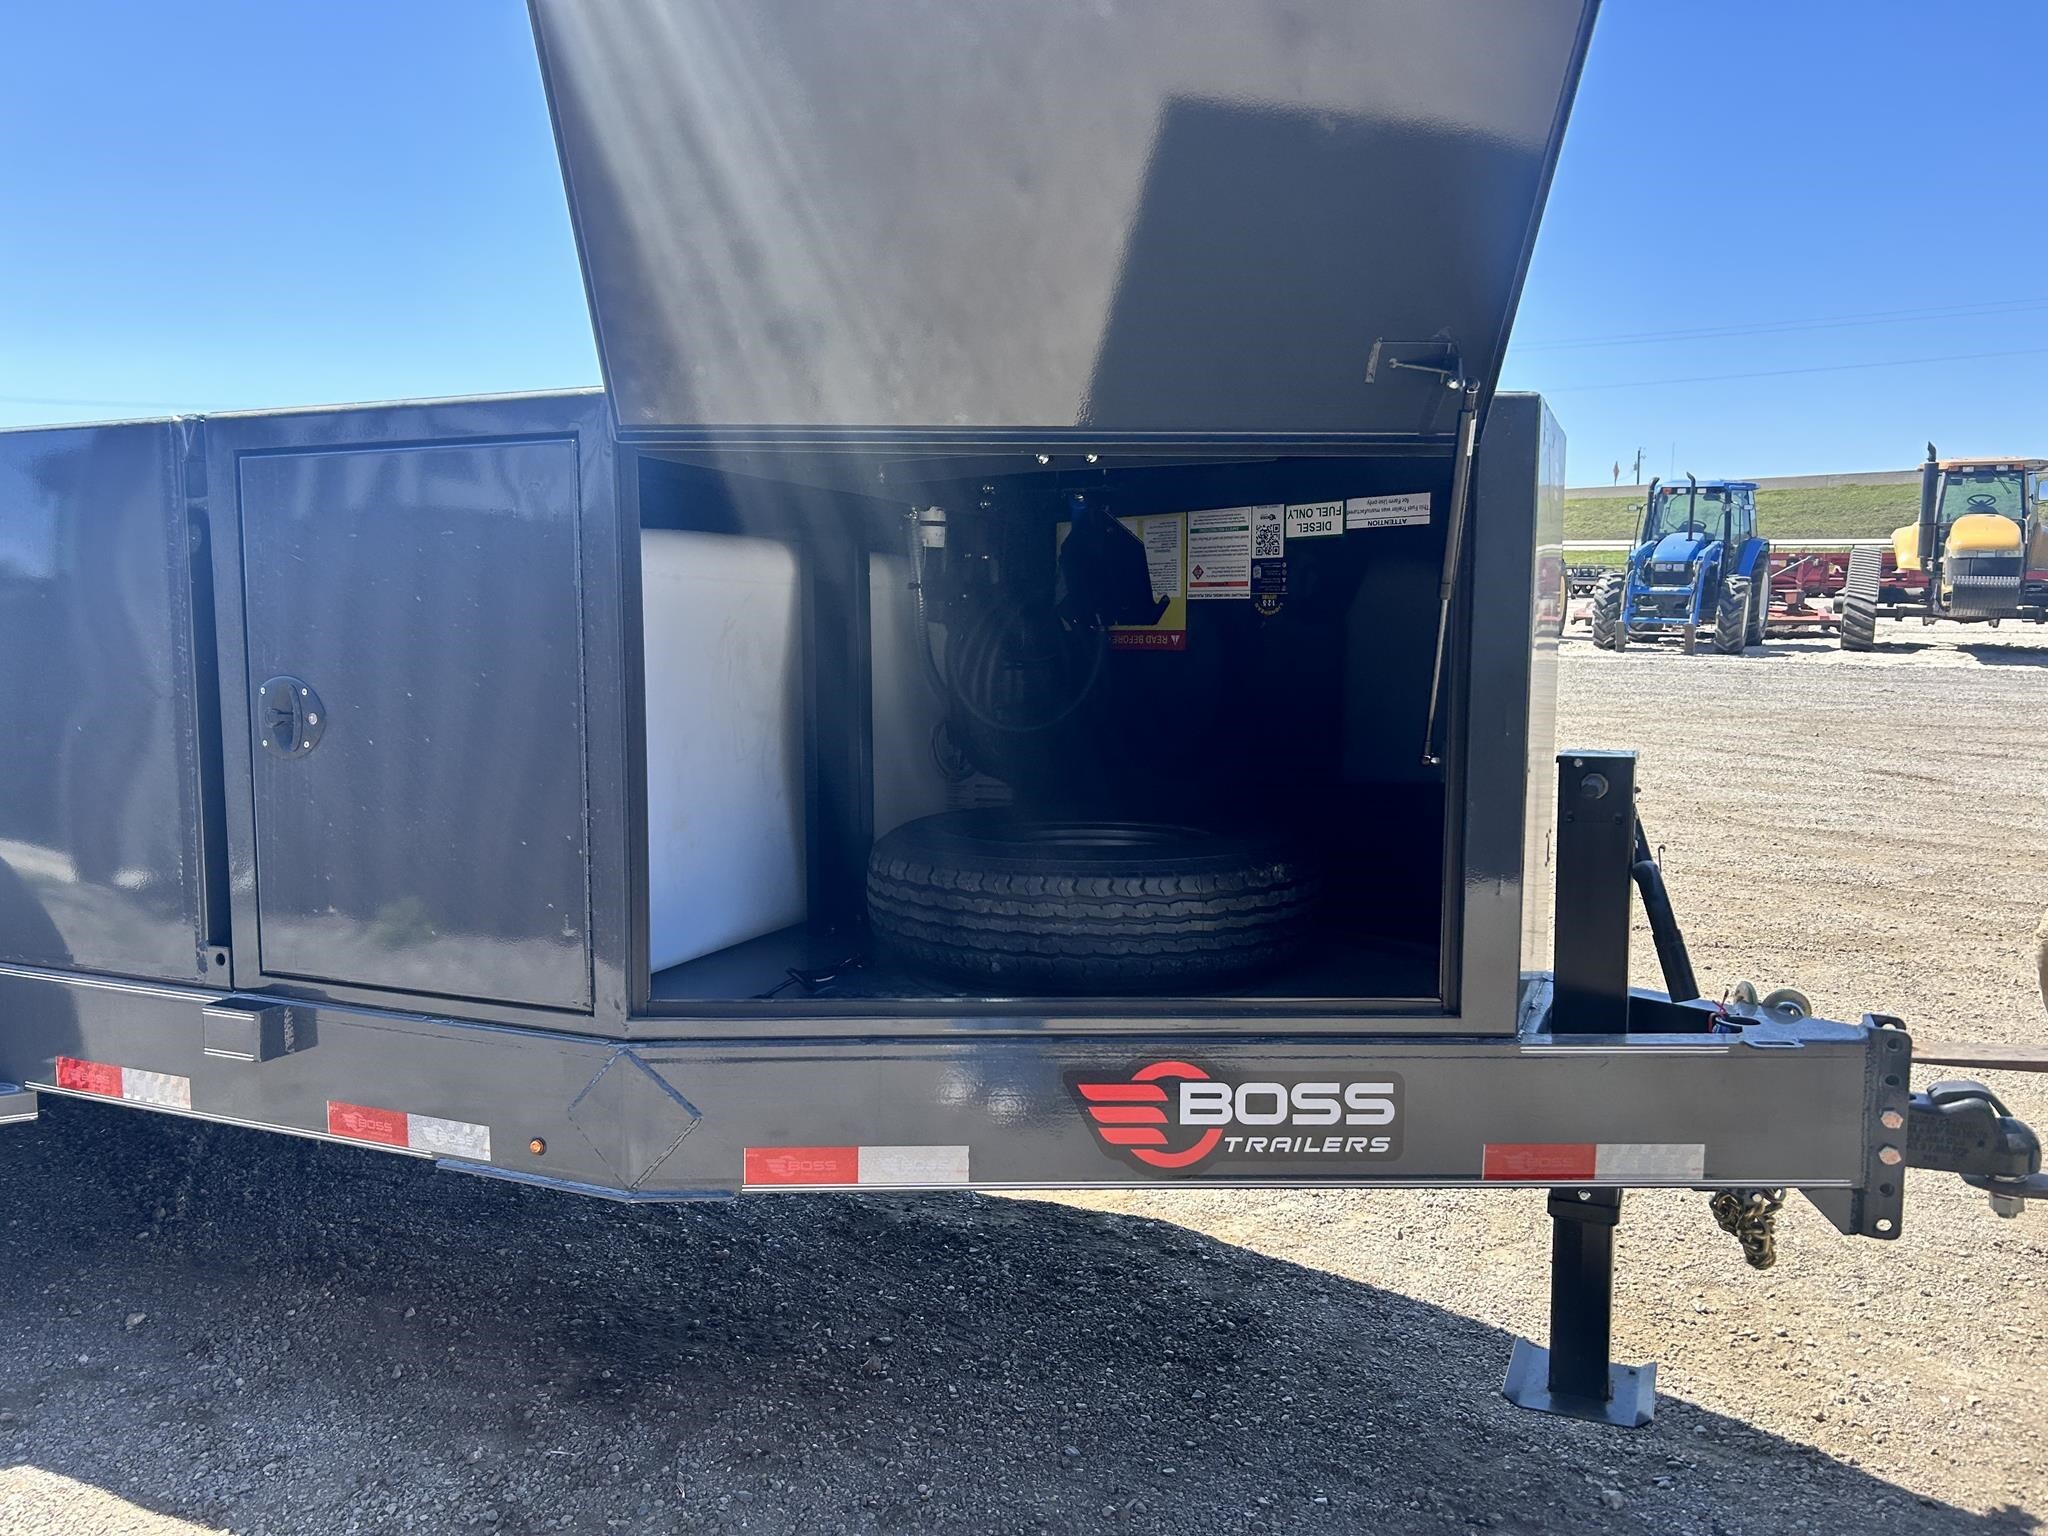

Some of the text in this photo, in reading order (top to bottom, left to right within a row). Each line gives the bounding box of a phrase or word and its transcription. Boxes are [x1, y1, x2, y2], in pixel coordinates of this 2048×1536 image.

[1288, 506, 1342, 520] FUEL ONLY
[1296, 521, 1332, 532] DIESEL
[1368, 518, 1408, 526] ATTENTION
[1112, 634, 1168, 644] READ BEFORE
[1180, 1082, 1395, 1126] BOSS
[357, 1119, 393, 1133] BOSS
[1224, 1136, 1392, 1154] TRAILERS
[788, 1160, 838, 1172] BOSS
